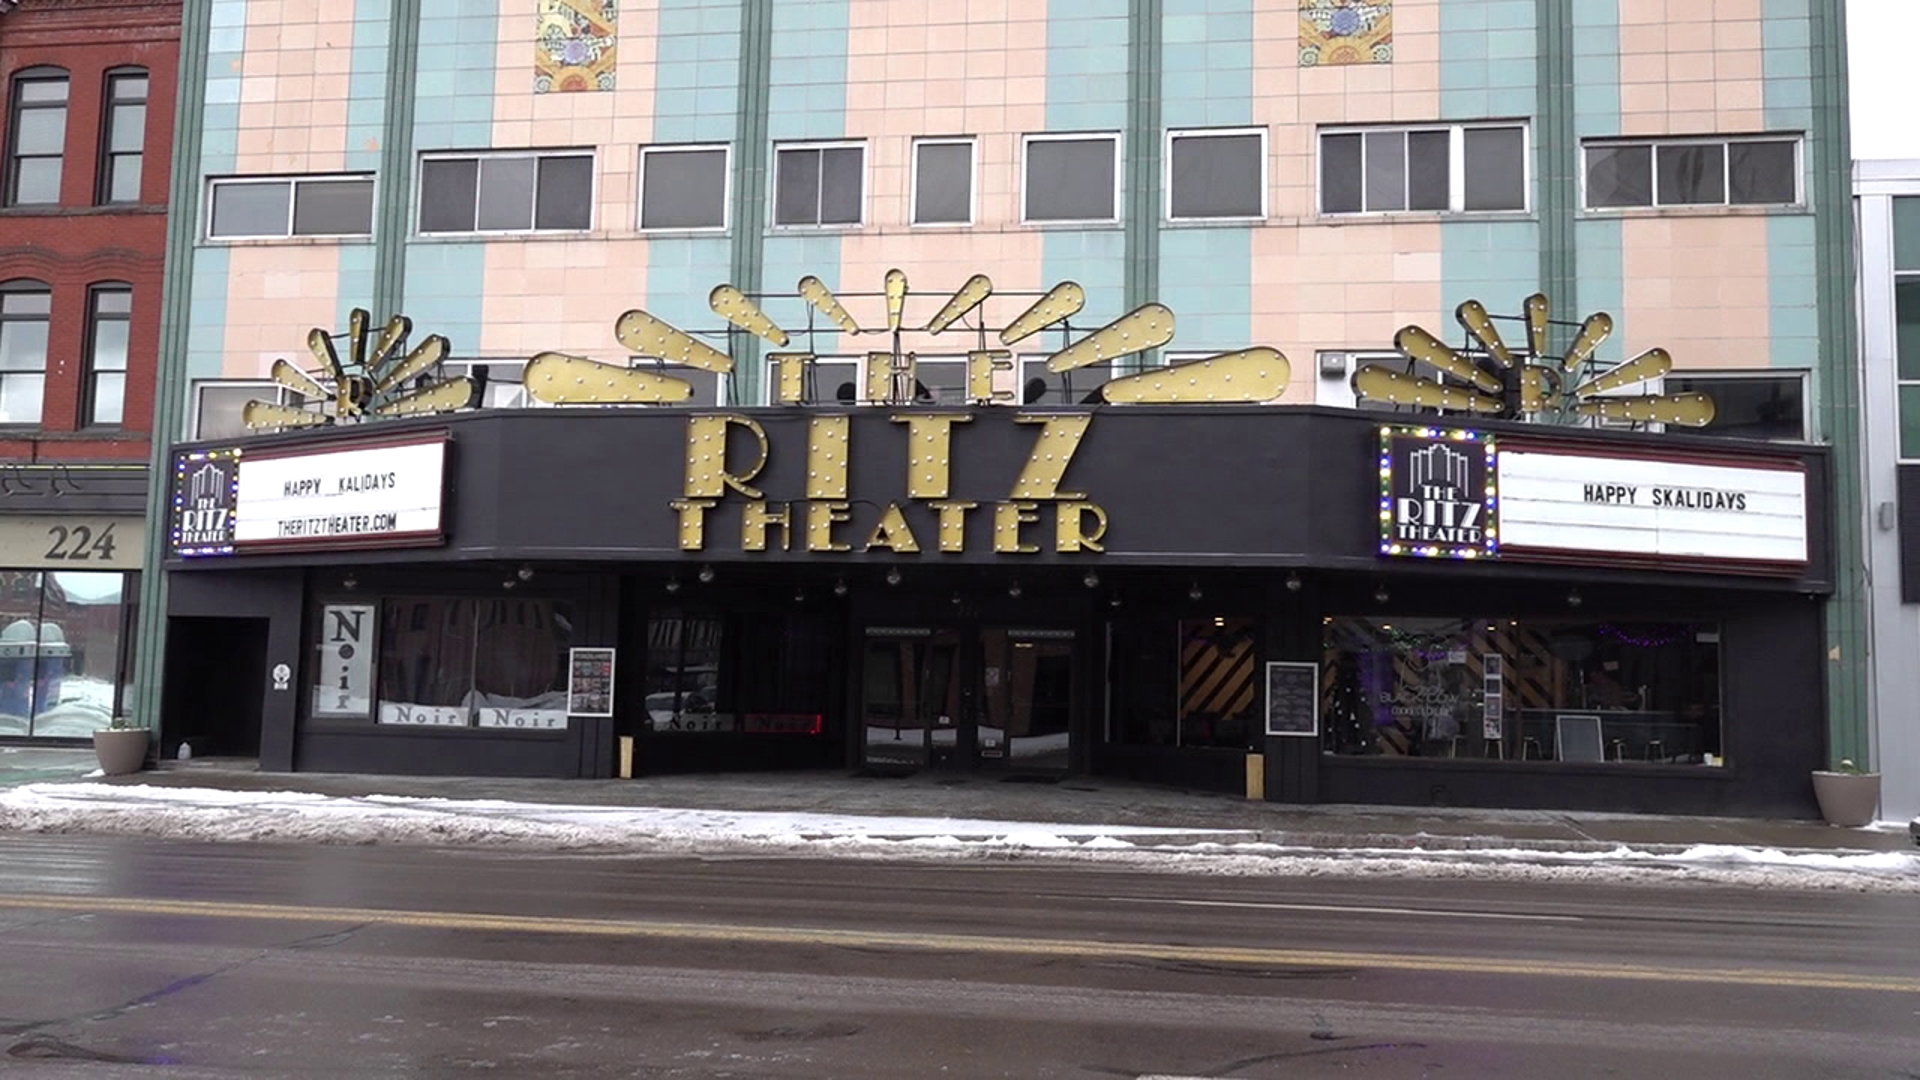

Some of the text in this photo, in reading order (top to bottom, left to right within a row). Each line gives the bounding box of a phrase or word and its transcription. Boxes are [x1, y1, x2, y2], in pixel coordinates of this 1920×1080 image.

[768, 350, 1014, 403] THE
[683, 413, 1093, 500] RITZ
[283, 478, 322, 497] HAPPY
[1422, 485, 1459, 501] THE
[1583, 483, 1747, 511] HAPPY SKALIDAYS
[197, 497, 215, 510] THE
[1397, 498, 1481, 529] RITZ
[183, 508, 228, 532] RITZ
[277, 513, 397, 536] THERITZTHEATER.COM
[670, 500, 1108, 553] THEATER
[44, 522, 116, 561] 224
[182, 530, 227, 544] THEATER
[1397, 525, 1482, 544] THEATER
[329, 610, 366, 710] Noir
[395, 706, 457, 724] Noir
[494, 709, 556, 728] Noir
[668, 714, 723, 730] Noir
